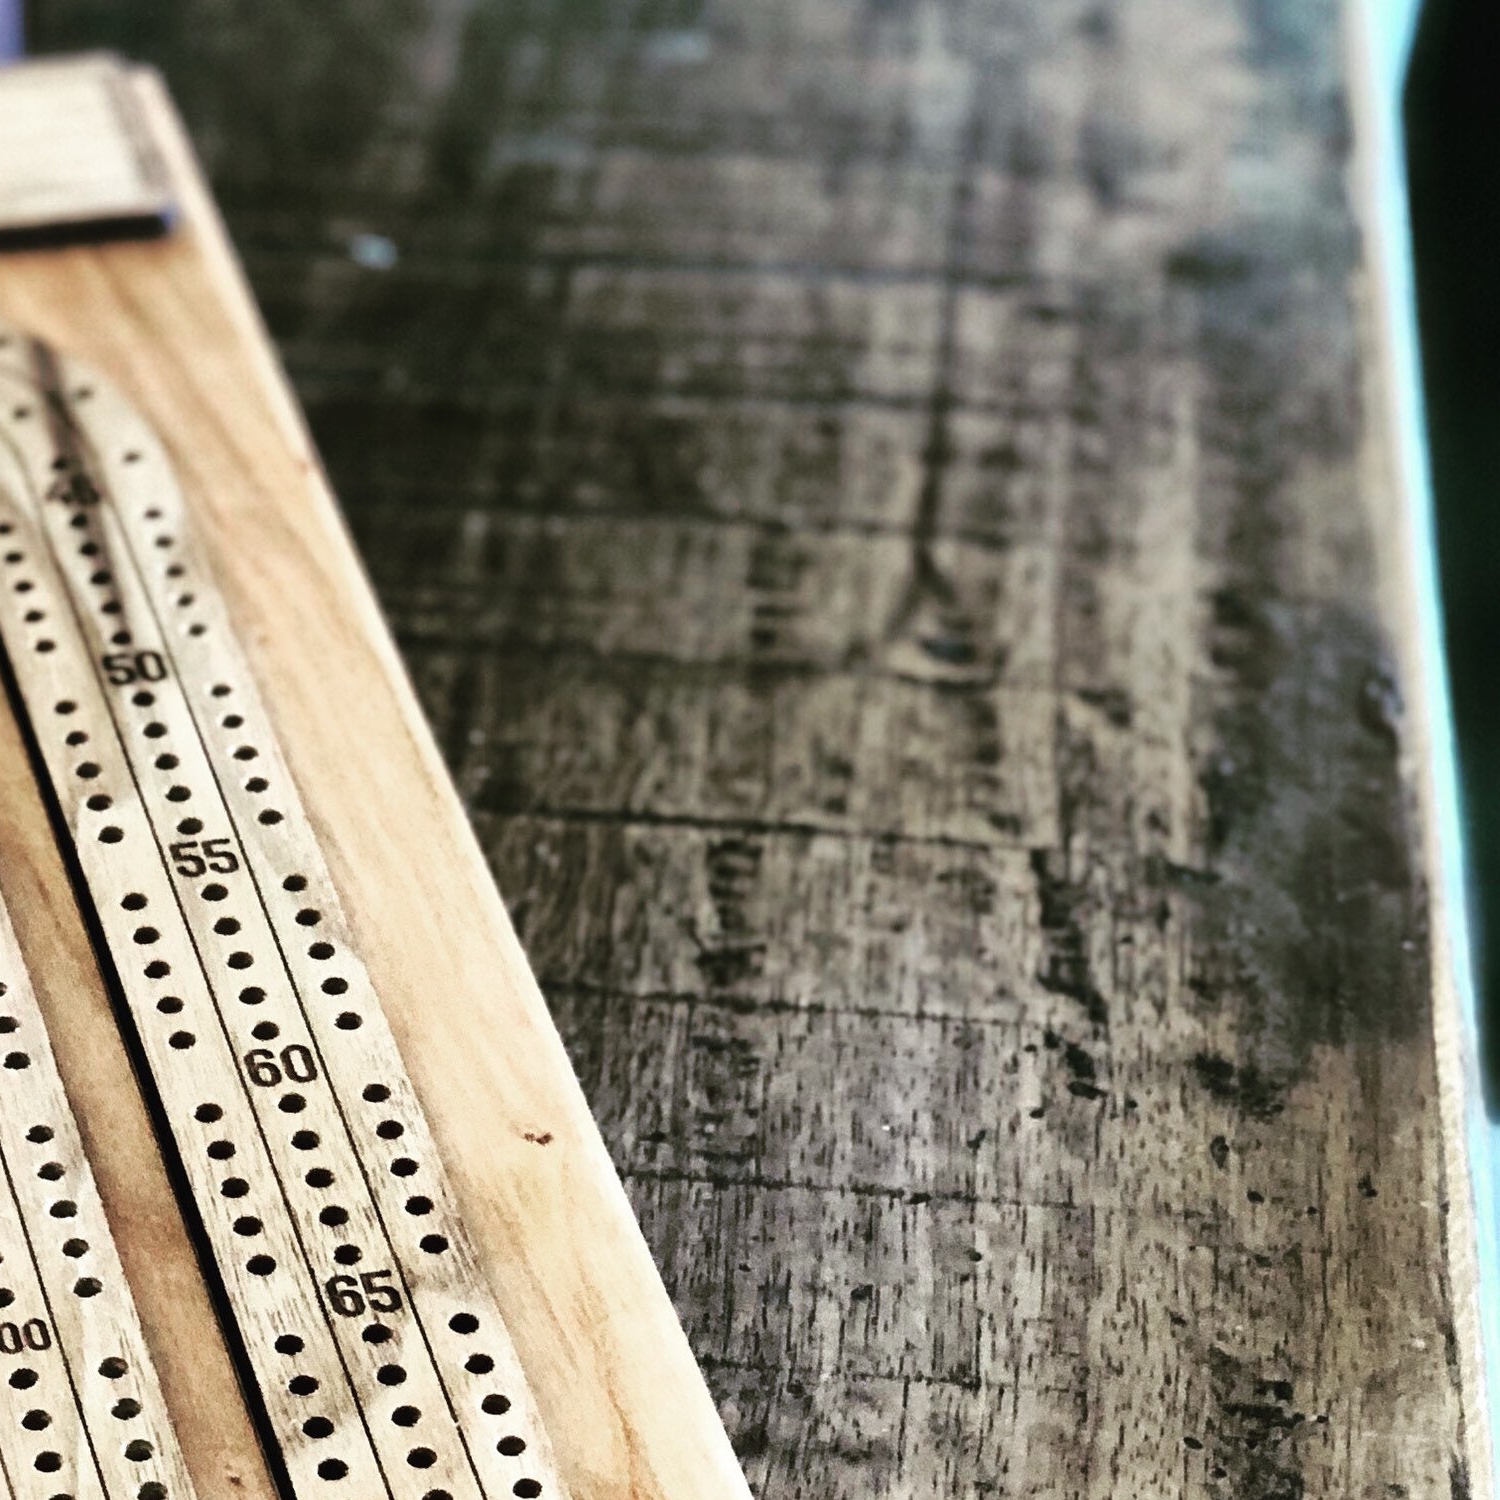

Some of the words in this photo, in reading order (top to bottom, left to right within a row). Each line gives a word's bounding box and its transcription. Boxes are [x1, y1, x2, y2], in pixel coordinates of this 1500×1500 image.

[102, 651, 168, 686] 50
[169, 838, 240, 879] 55
[243, 1043, 319, 1089] 60
[325, 1269, 402, 1318] 65
